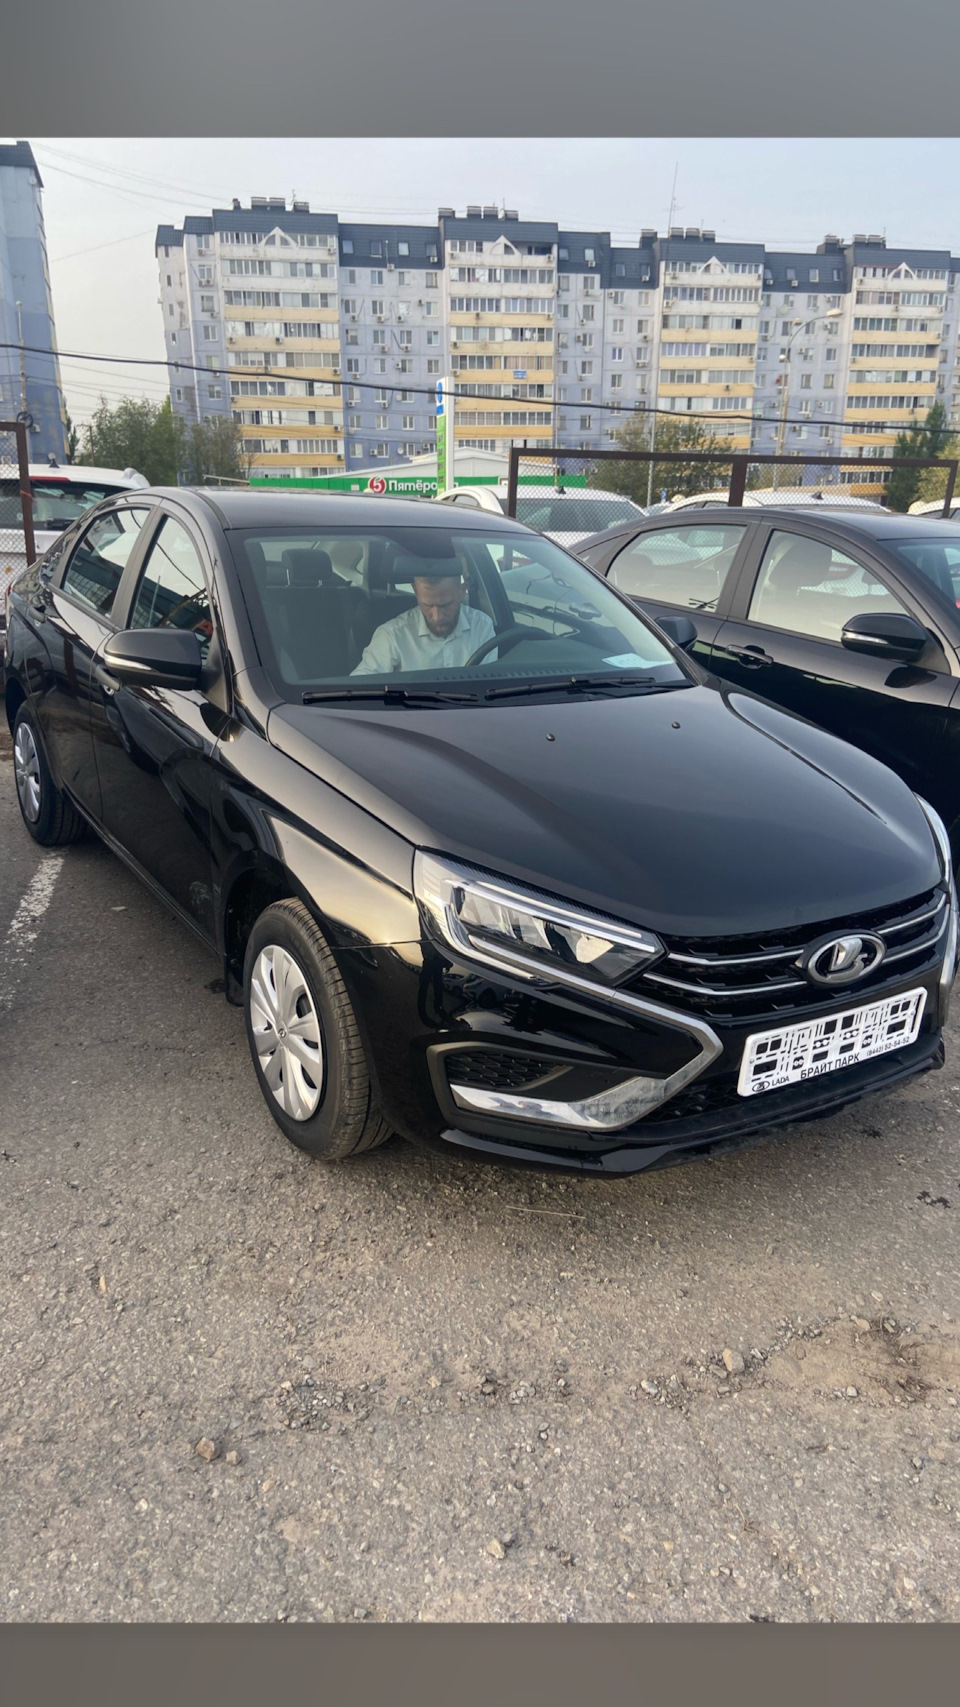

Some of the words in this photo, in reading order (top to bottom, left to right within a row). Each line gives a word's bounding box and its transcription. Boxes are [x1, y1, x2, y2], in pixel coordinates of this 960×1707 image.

[389, 480, 459, 493] Пятёро
[866, 1046, 884, 1056] (8442)
[884, 1036, 910, 1051] 52-54-52
[801, 1060, 833, 1079] БРАЙТ
[834, 1052, 860, 1069] ПАРК
[772, 1076, 789, 1086] LADA
